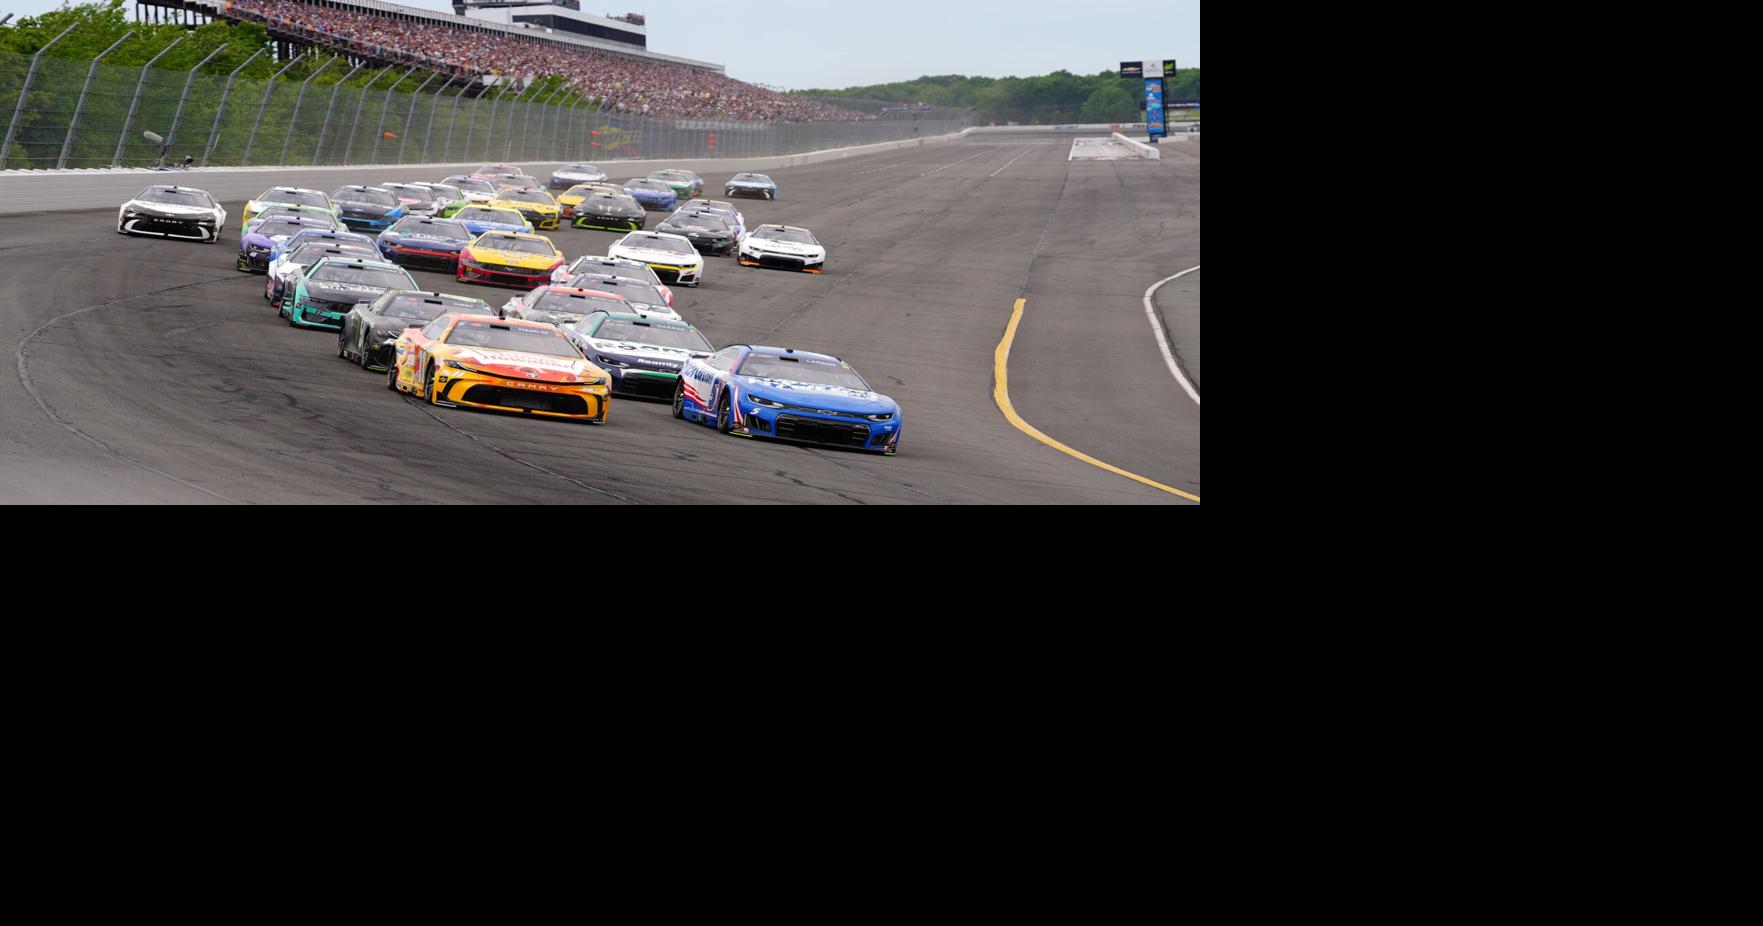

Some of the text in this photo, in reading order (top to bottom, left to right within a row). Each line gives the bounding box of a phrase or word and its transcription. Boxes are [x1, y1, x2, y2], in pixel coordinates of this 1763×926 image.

[637, 358, 679, 369] Roamly
[505, 380, 559, 392] CAMRY
[749, 406, 762, 416] 5
